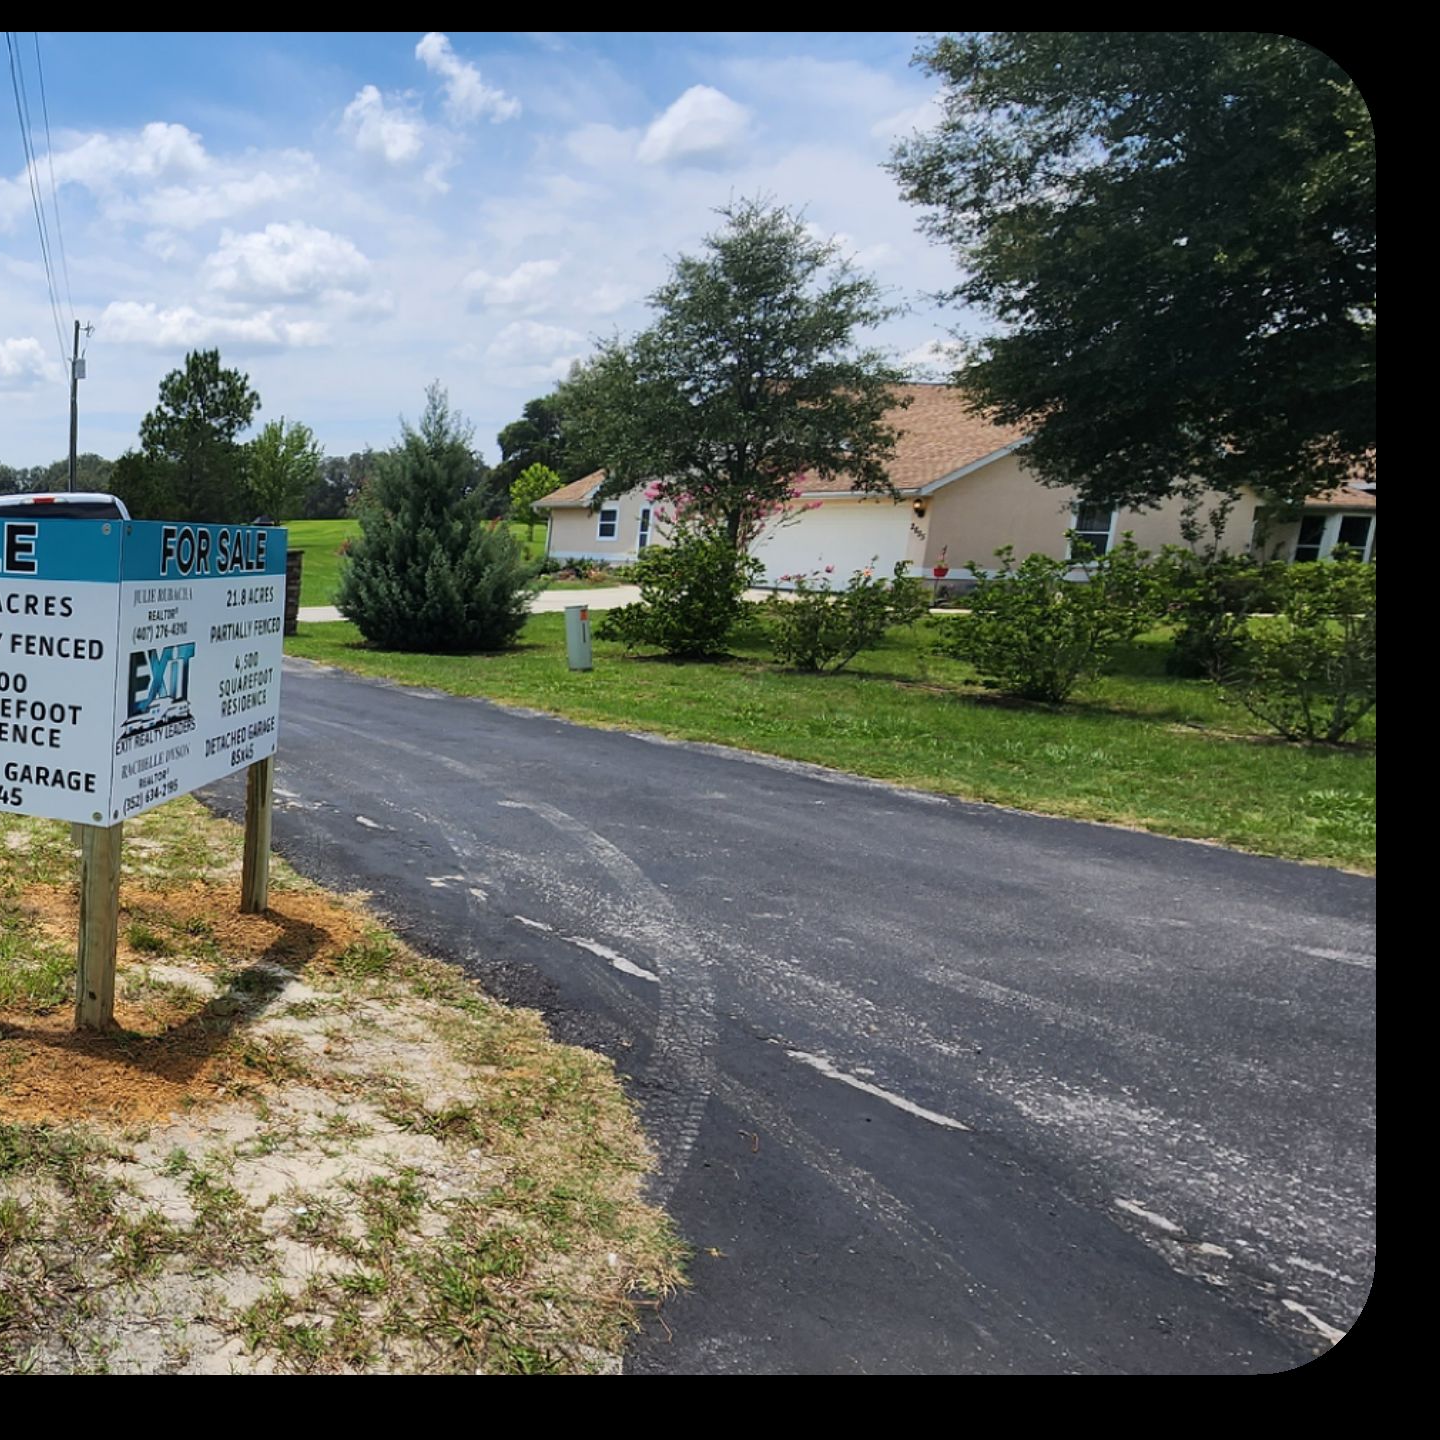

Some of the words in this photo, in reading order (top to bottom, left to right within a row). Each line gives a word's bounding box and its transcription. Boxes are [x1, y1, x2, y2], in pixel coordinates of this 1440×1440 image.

[160, 525, 211, 577] FOR
[216, 528, 268, 574] SALE
[226, 588, 246, 607] 21.8
[248, 586, 274, 604] ACRES
[210, 620, 253, 643] PARTIALLY
[254, 617, 280, 636] FENCED
[11, 633, 104, 661] FENCED
[234, 651, 259, 673] 4,500
[218, 668, 273, 698] SQUAREFOOT
[221, 689, 267, 718] RESIDENCE
[205, 726, 246, 757] DETACHED
[248, 716, 275, 740] GARAGE
[4, 762, 97, 793] GARAGE
